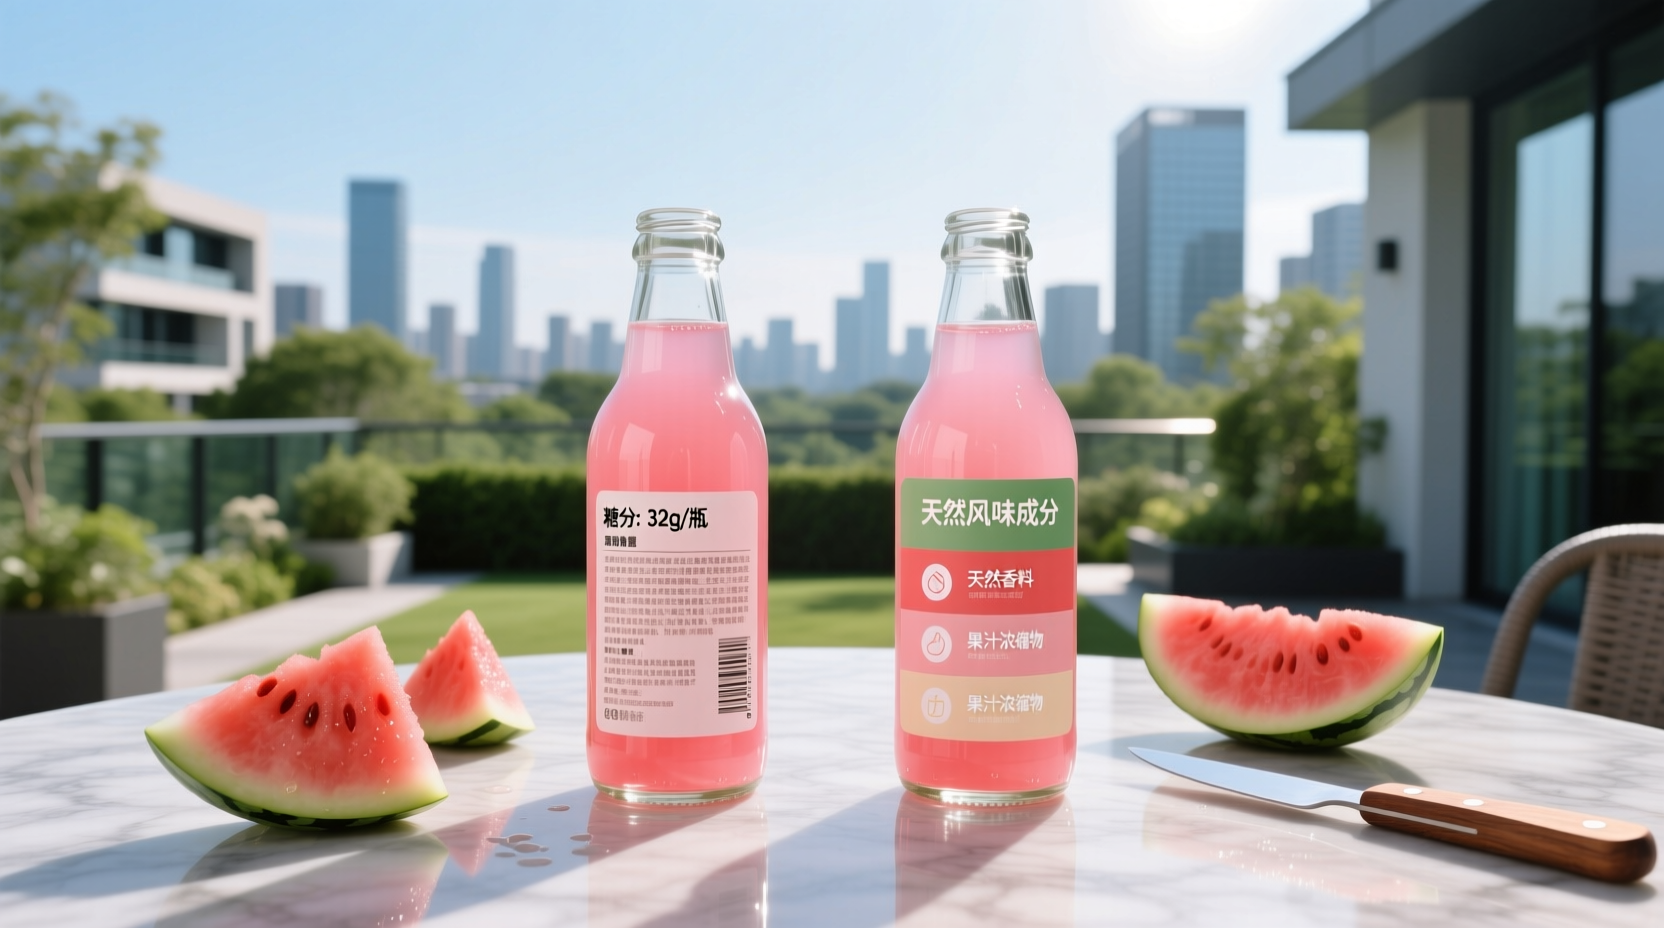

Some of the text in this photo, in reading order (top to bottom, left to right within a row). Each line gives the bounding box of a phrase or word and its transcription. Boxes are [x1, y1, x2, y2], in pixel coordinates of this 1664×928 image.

[603, 506, 708, 532] 糖分: 32g/瓶
[921, 498, 1059, 527] 天然风味成分
[967, 568, 1034, 588] 天然香料
